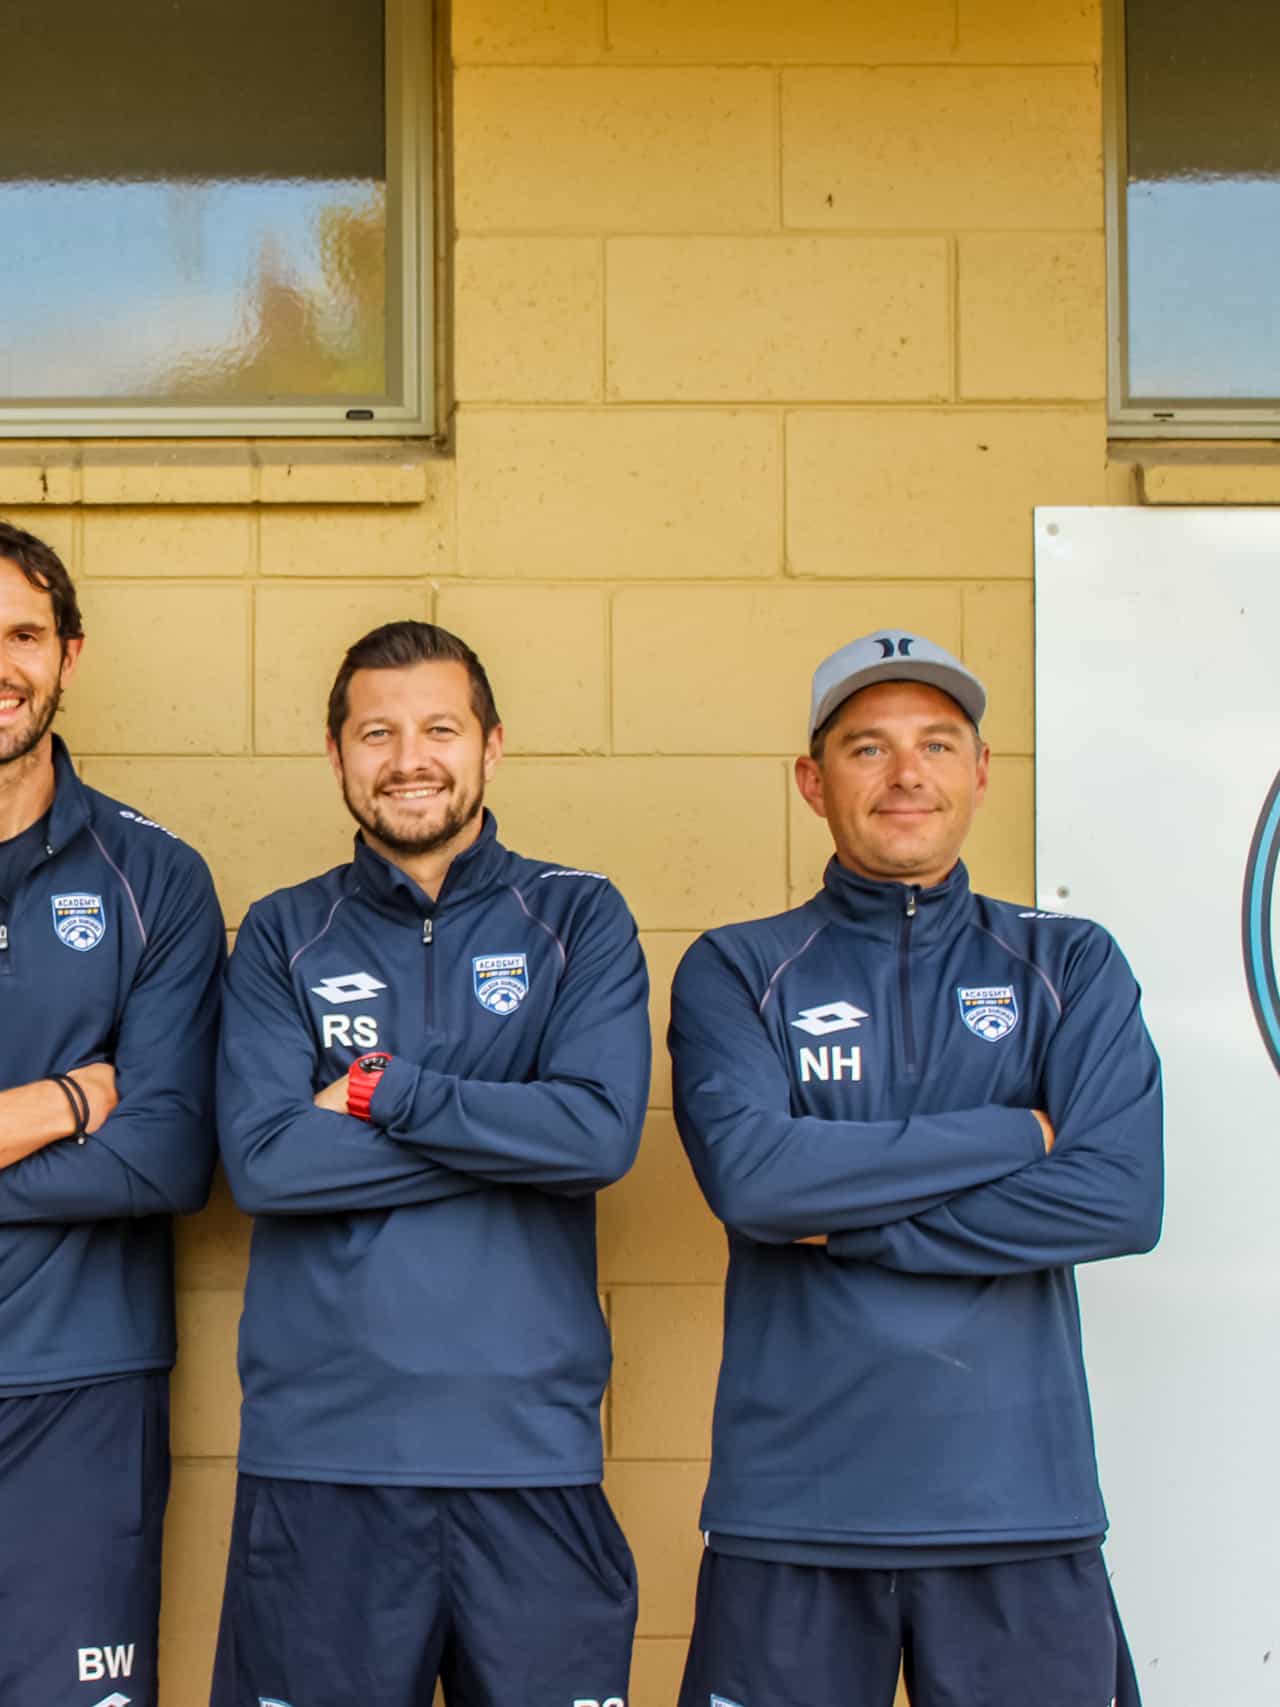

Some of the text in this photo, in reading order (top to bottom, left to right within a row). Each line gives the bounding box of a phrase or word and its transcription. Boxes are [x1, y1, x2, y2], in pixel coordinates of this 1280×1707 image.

[57, 898, 97, 907] ACADEMY
[479, 959, 520, 969] ACADEMY
[322, 1014, 379, 1048] RS
[799, 1045, 861, 1082] NH
[77, 1643, 135, 1682] BW
